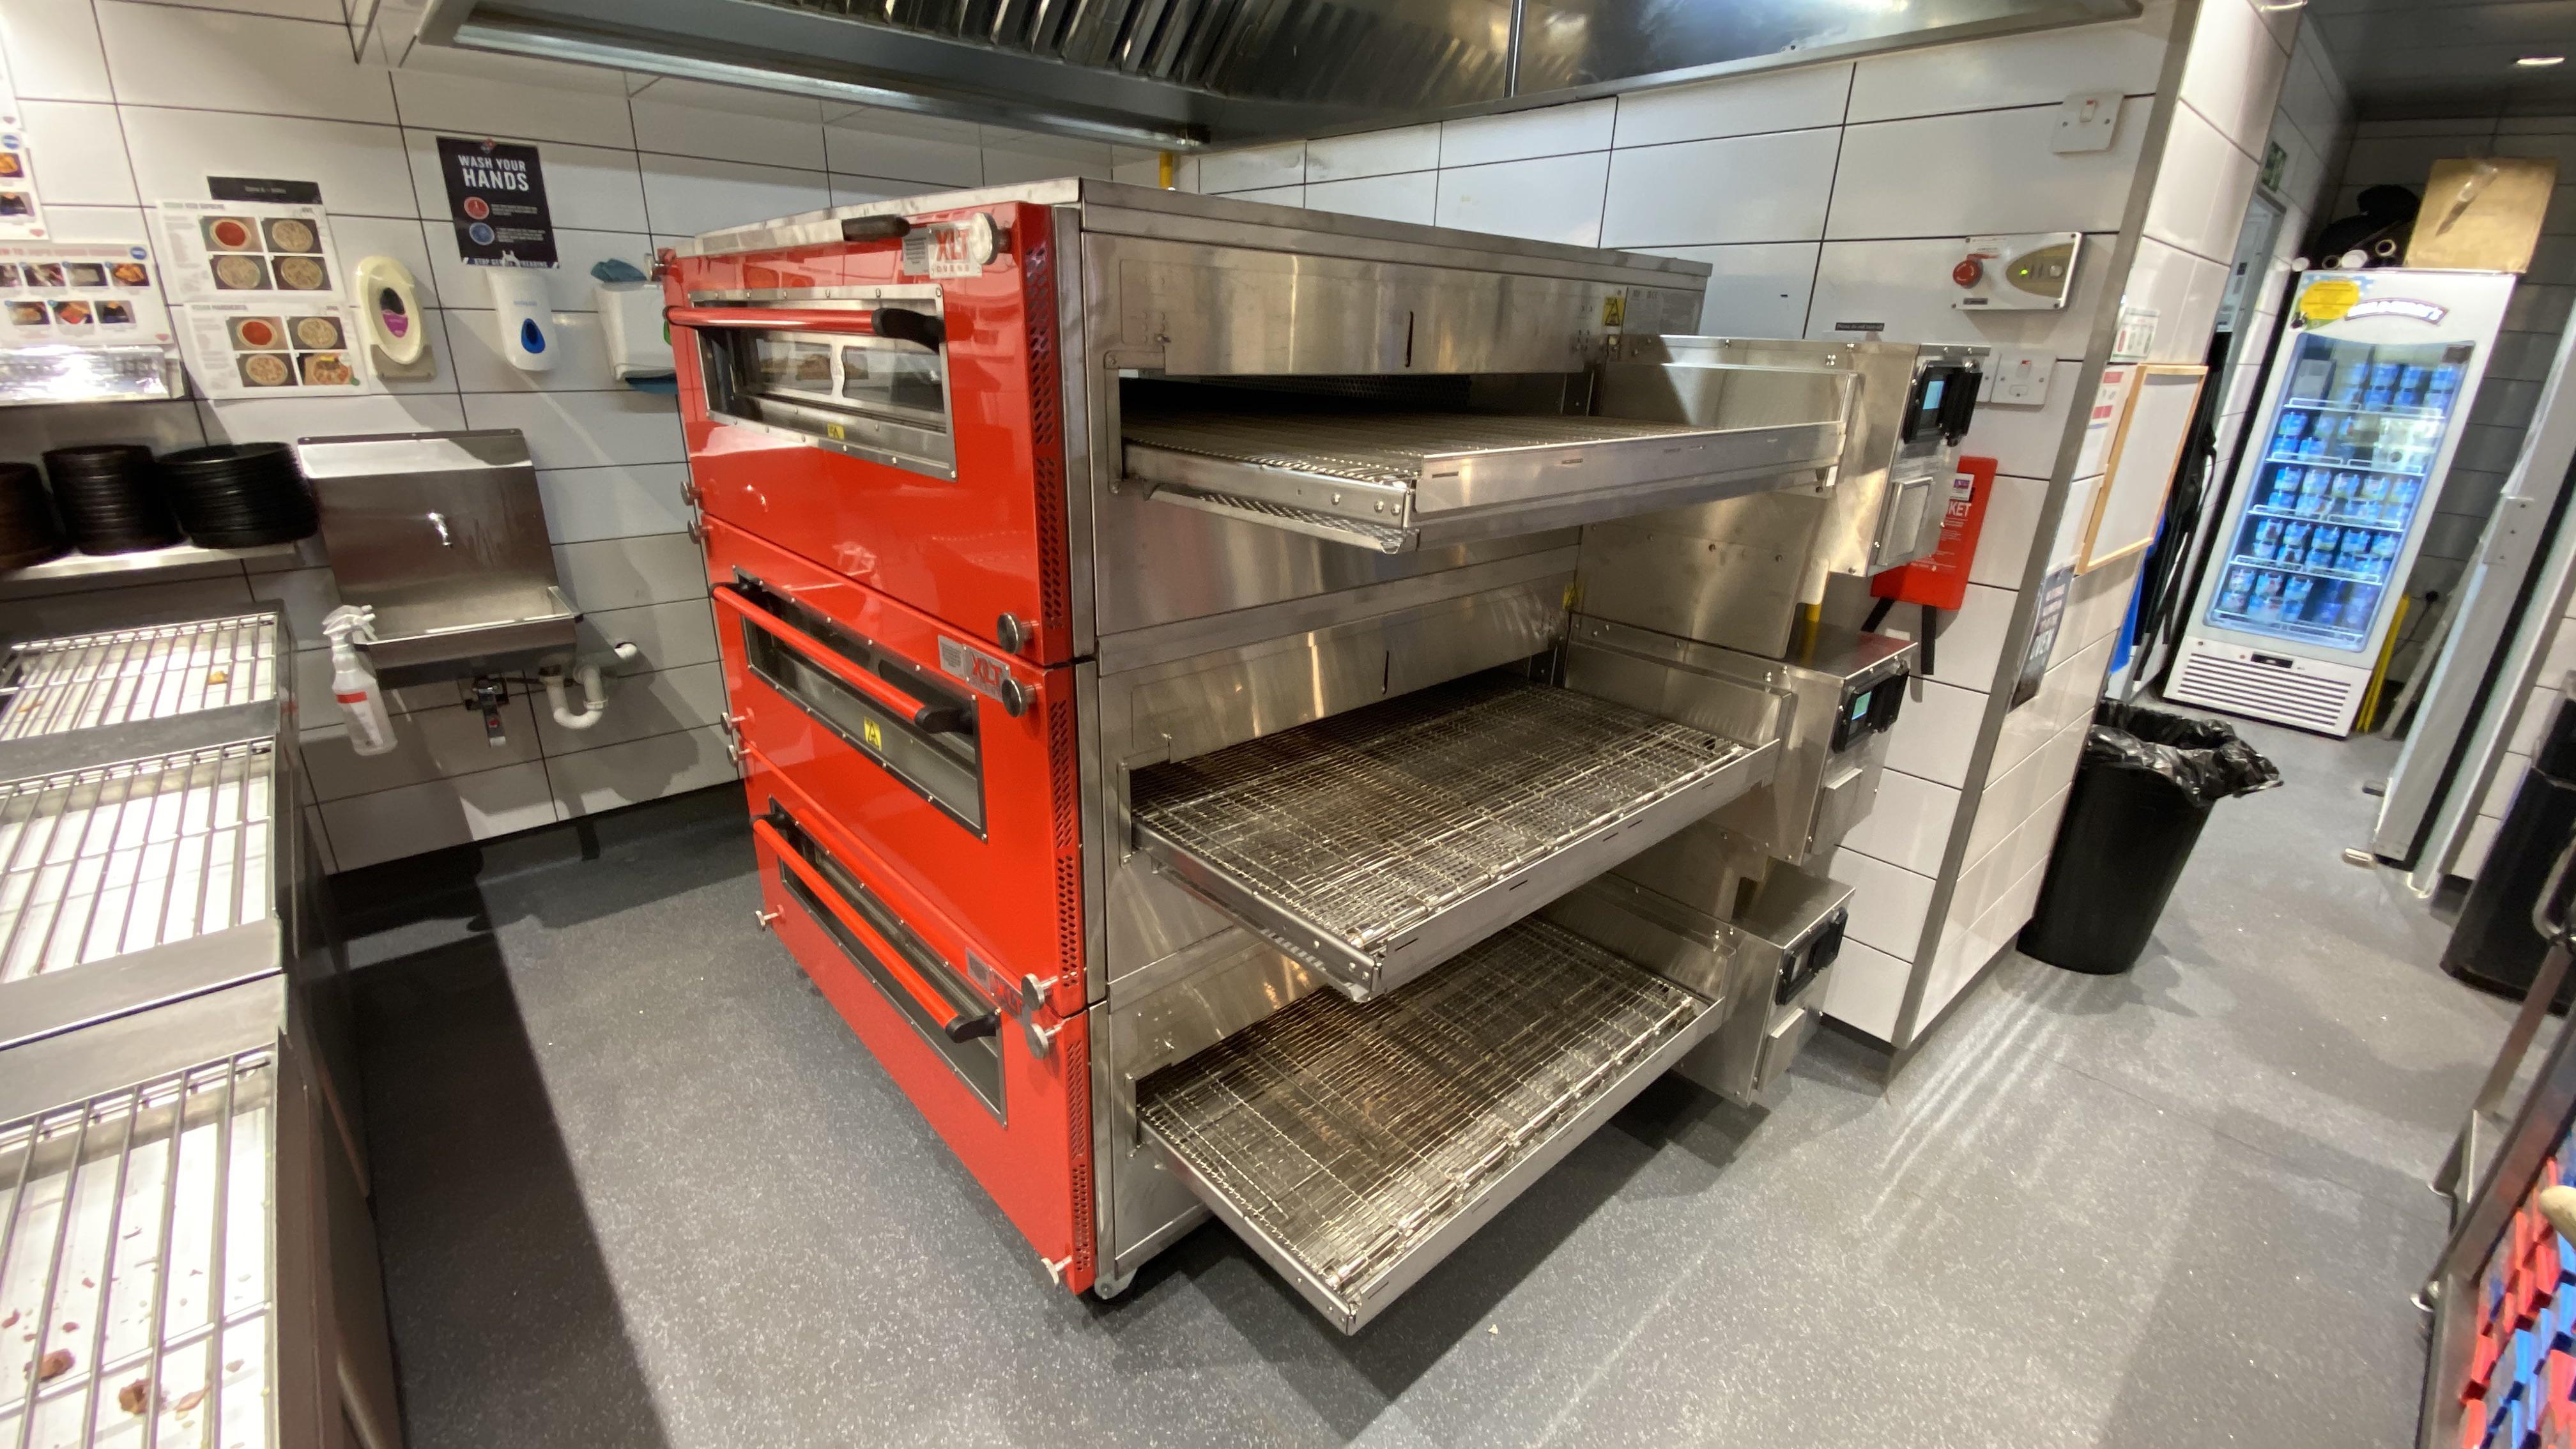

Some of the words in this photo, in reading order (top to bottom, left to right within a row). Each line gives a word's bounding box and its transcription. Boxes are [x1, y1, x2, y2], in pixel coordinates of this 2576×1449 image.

[458, 155, 493, 168] WASH
[496, 158, 527, 172] YOUR
[463, 167, 530, 192] HANDS
[935, 228, 970, 261] XLT
[1949, 501, 1972, 518] KET
[972, 652, 1002, 687] XLT
